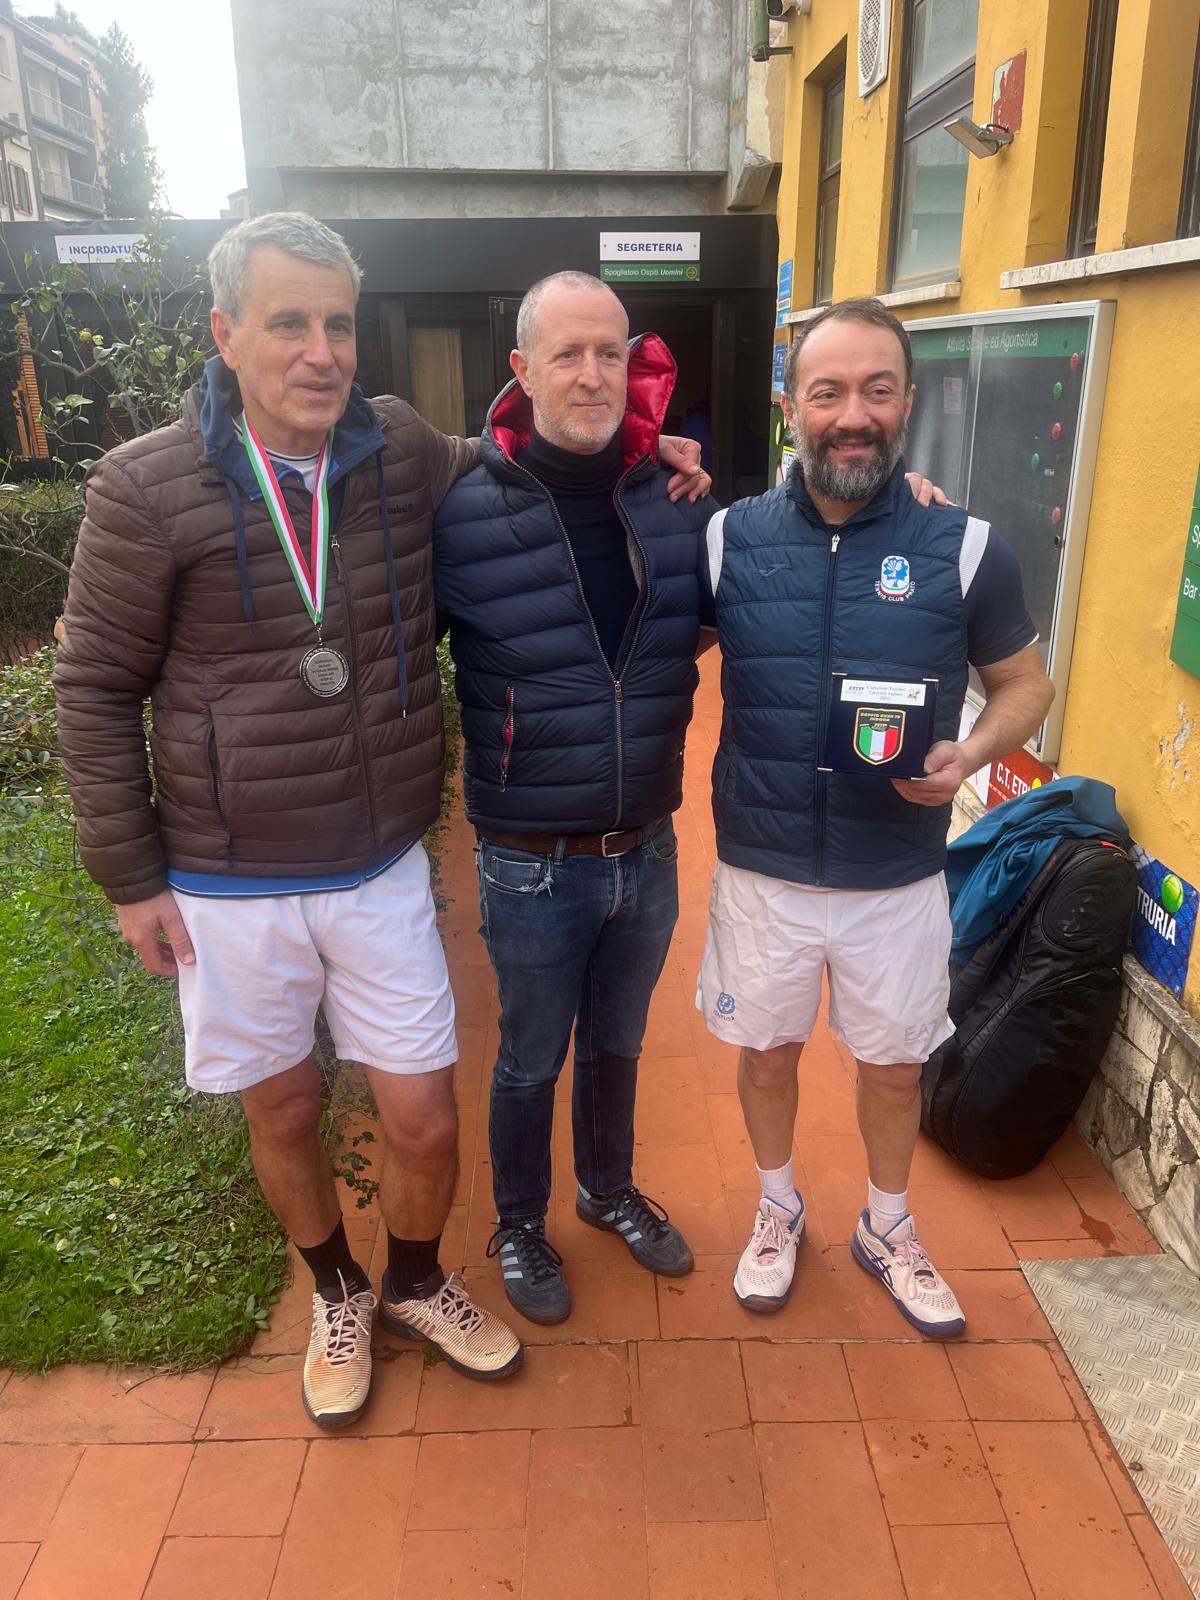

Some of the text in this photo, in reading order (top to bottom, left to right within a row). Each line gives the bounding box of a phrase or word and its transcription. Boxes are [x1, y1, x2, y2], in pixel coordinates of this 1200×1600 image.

[68, 244, 139, 255] INCORDATU
[617, 243, 683, 252] SEGRETERIA
[640, 268, 659, 277] Ospiti
[660, 268, 684, 276] Uomini
[874, 581, 887, 600] TENNIS
[905, 580, 916, 599] PRATO
[1183, 577, 1198, 600] Bar
[996, 762, 1011, 790] C.T.
[1136, 885, 1176, 947] TRURIA
